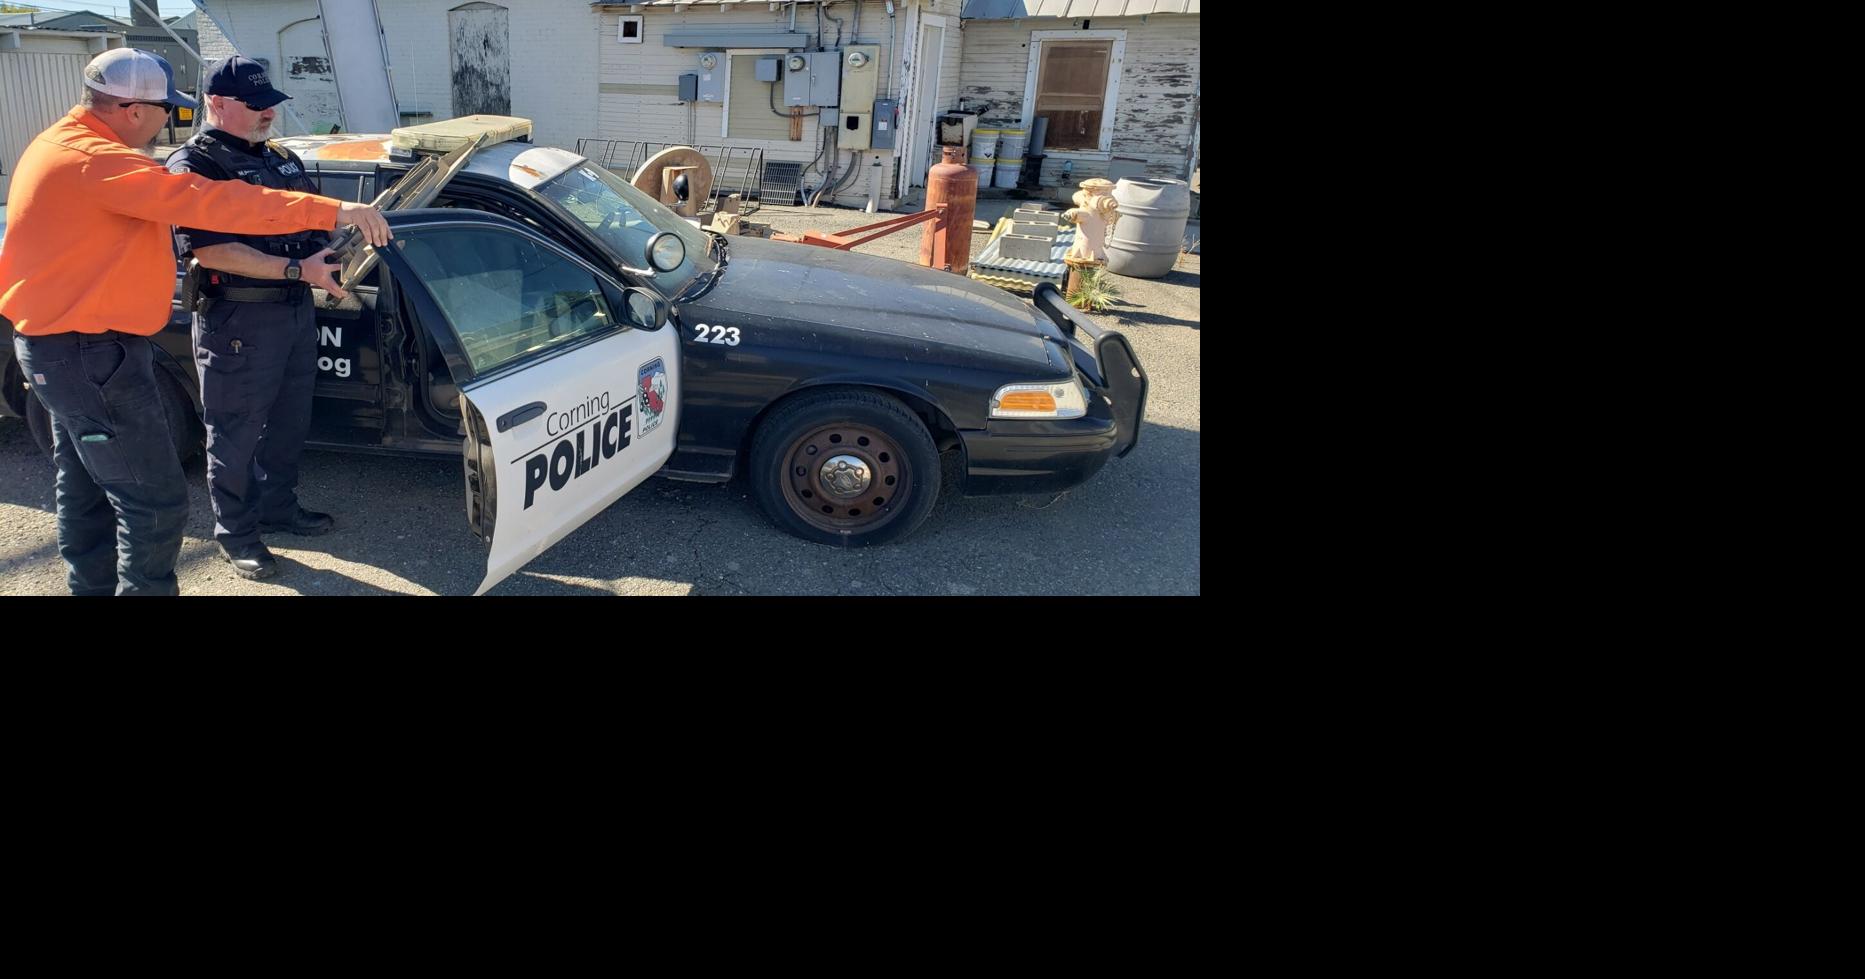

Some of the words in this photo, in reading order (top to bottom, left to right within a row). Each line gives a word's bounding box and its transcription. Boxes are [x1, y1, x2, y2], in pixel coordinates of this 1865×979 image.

[316, 325, 342, 348] N
[694, 323, 741, 347] 223
[317, 356, 351, 378] og
[640, 361, 661, 376] CORNING
[546, 391, 610, 437] Corning
[523, 403, 633, 511] POLICE
